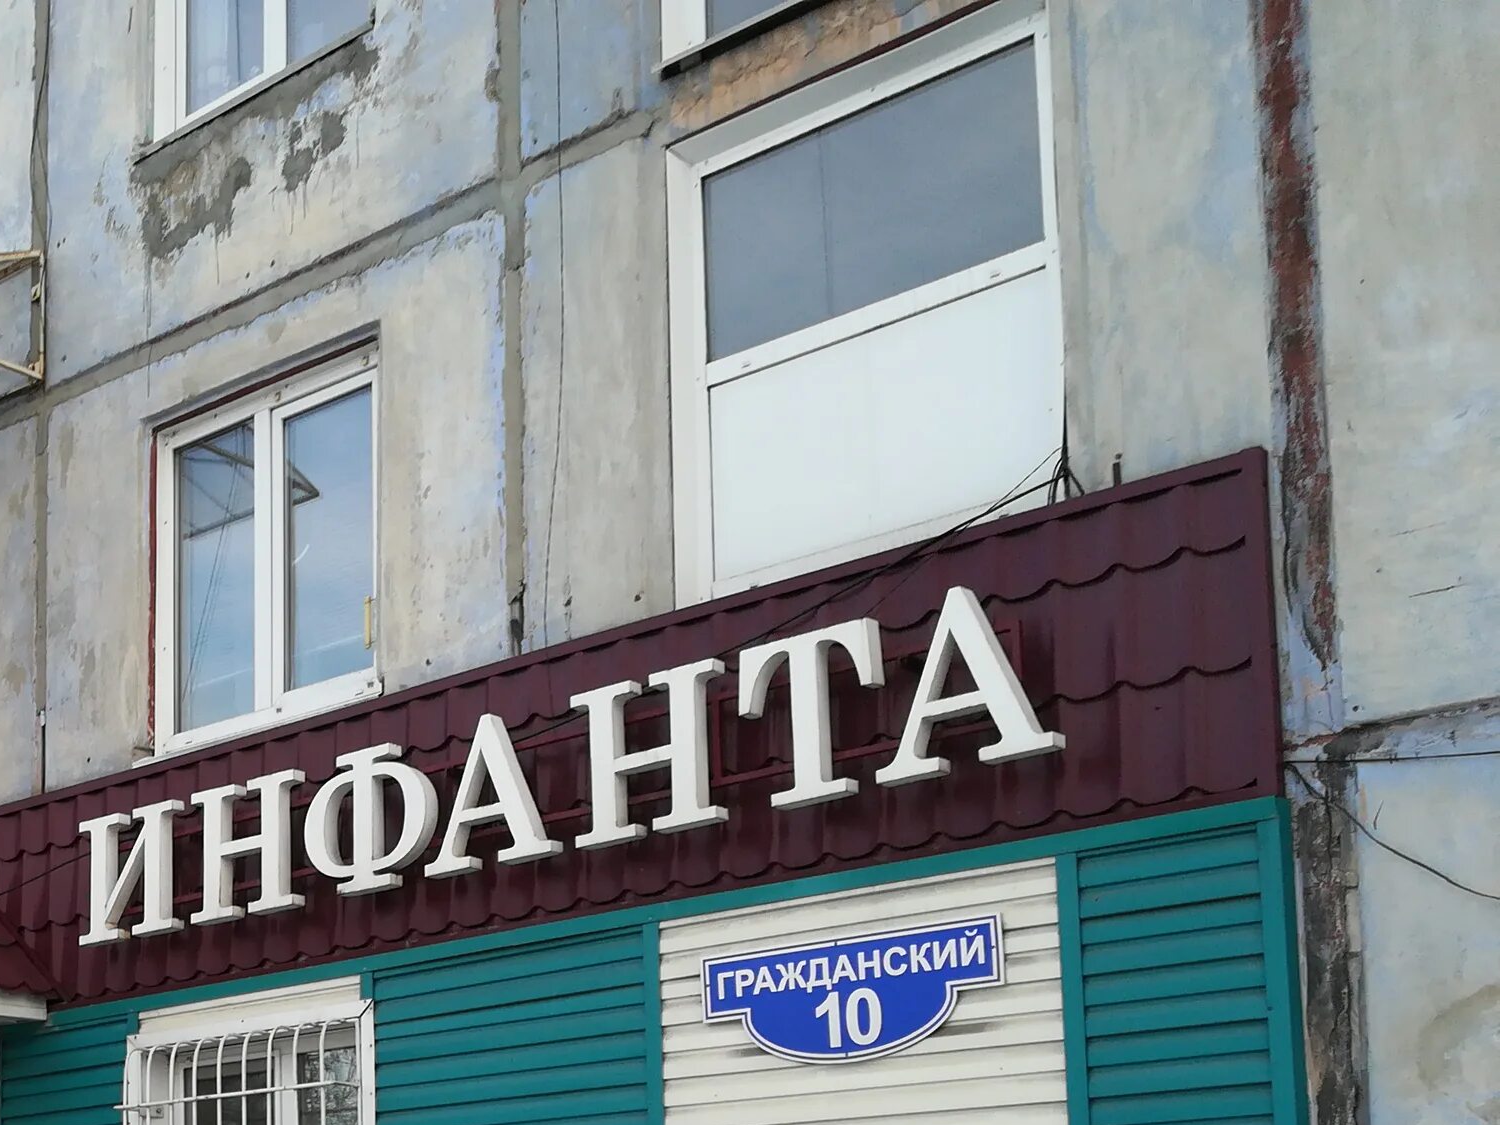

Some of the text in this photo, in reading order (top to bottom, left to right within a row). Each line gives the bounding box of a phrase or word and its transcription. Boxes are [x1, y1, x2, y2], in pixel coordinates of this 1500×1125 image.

[78, 586, 1066, 947] ИНФАНТА
[716, 928, 986, 1000] ГРАЖДАНСКИЙ
[815, 987, 883, 1049] 10
